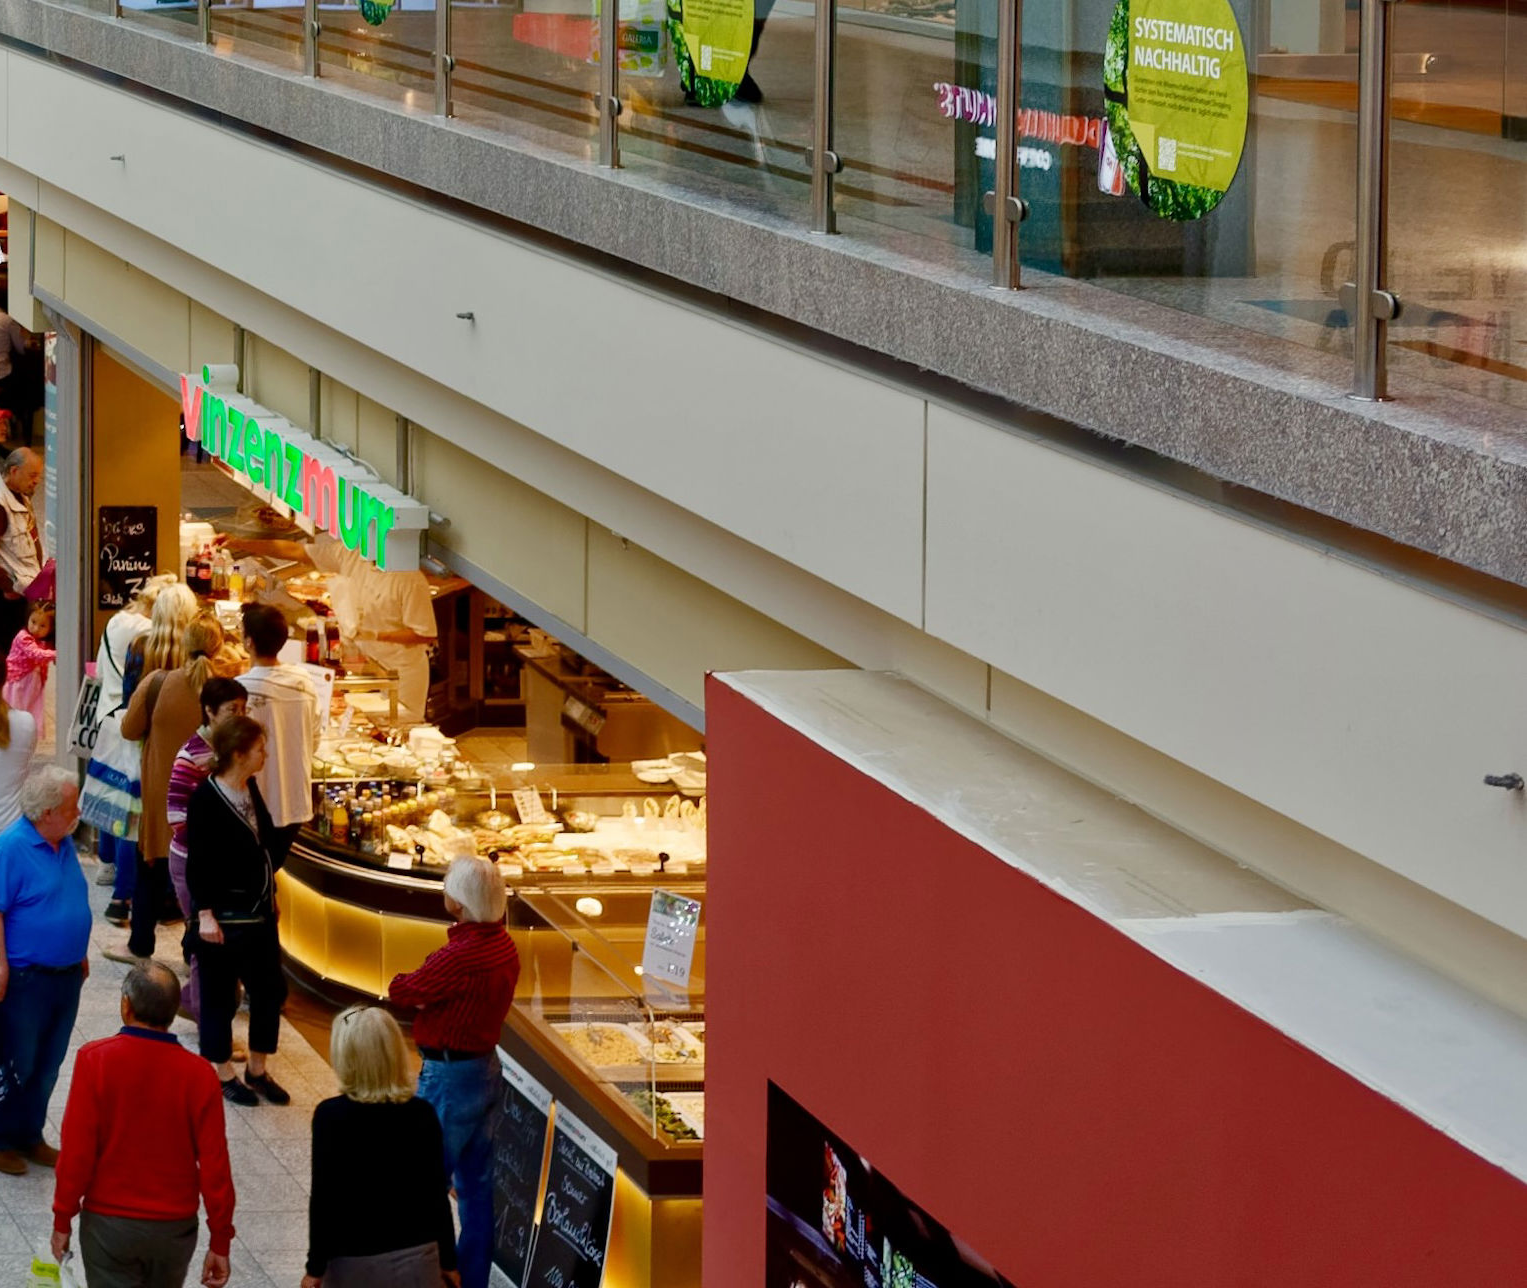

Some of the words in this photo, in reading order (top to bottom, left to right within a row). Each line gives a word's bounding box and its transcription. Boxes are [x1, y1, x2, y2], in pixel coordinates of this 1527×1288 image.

[1135, 16, 1234, 52] SYSTEMATISCH
[1134, 45, 1221, 79] NACHHALTIG
[180, 363, 394, 572] vinzenzmurr
[100, 543, 152, 572] Panini
